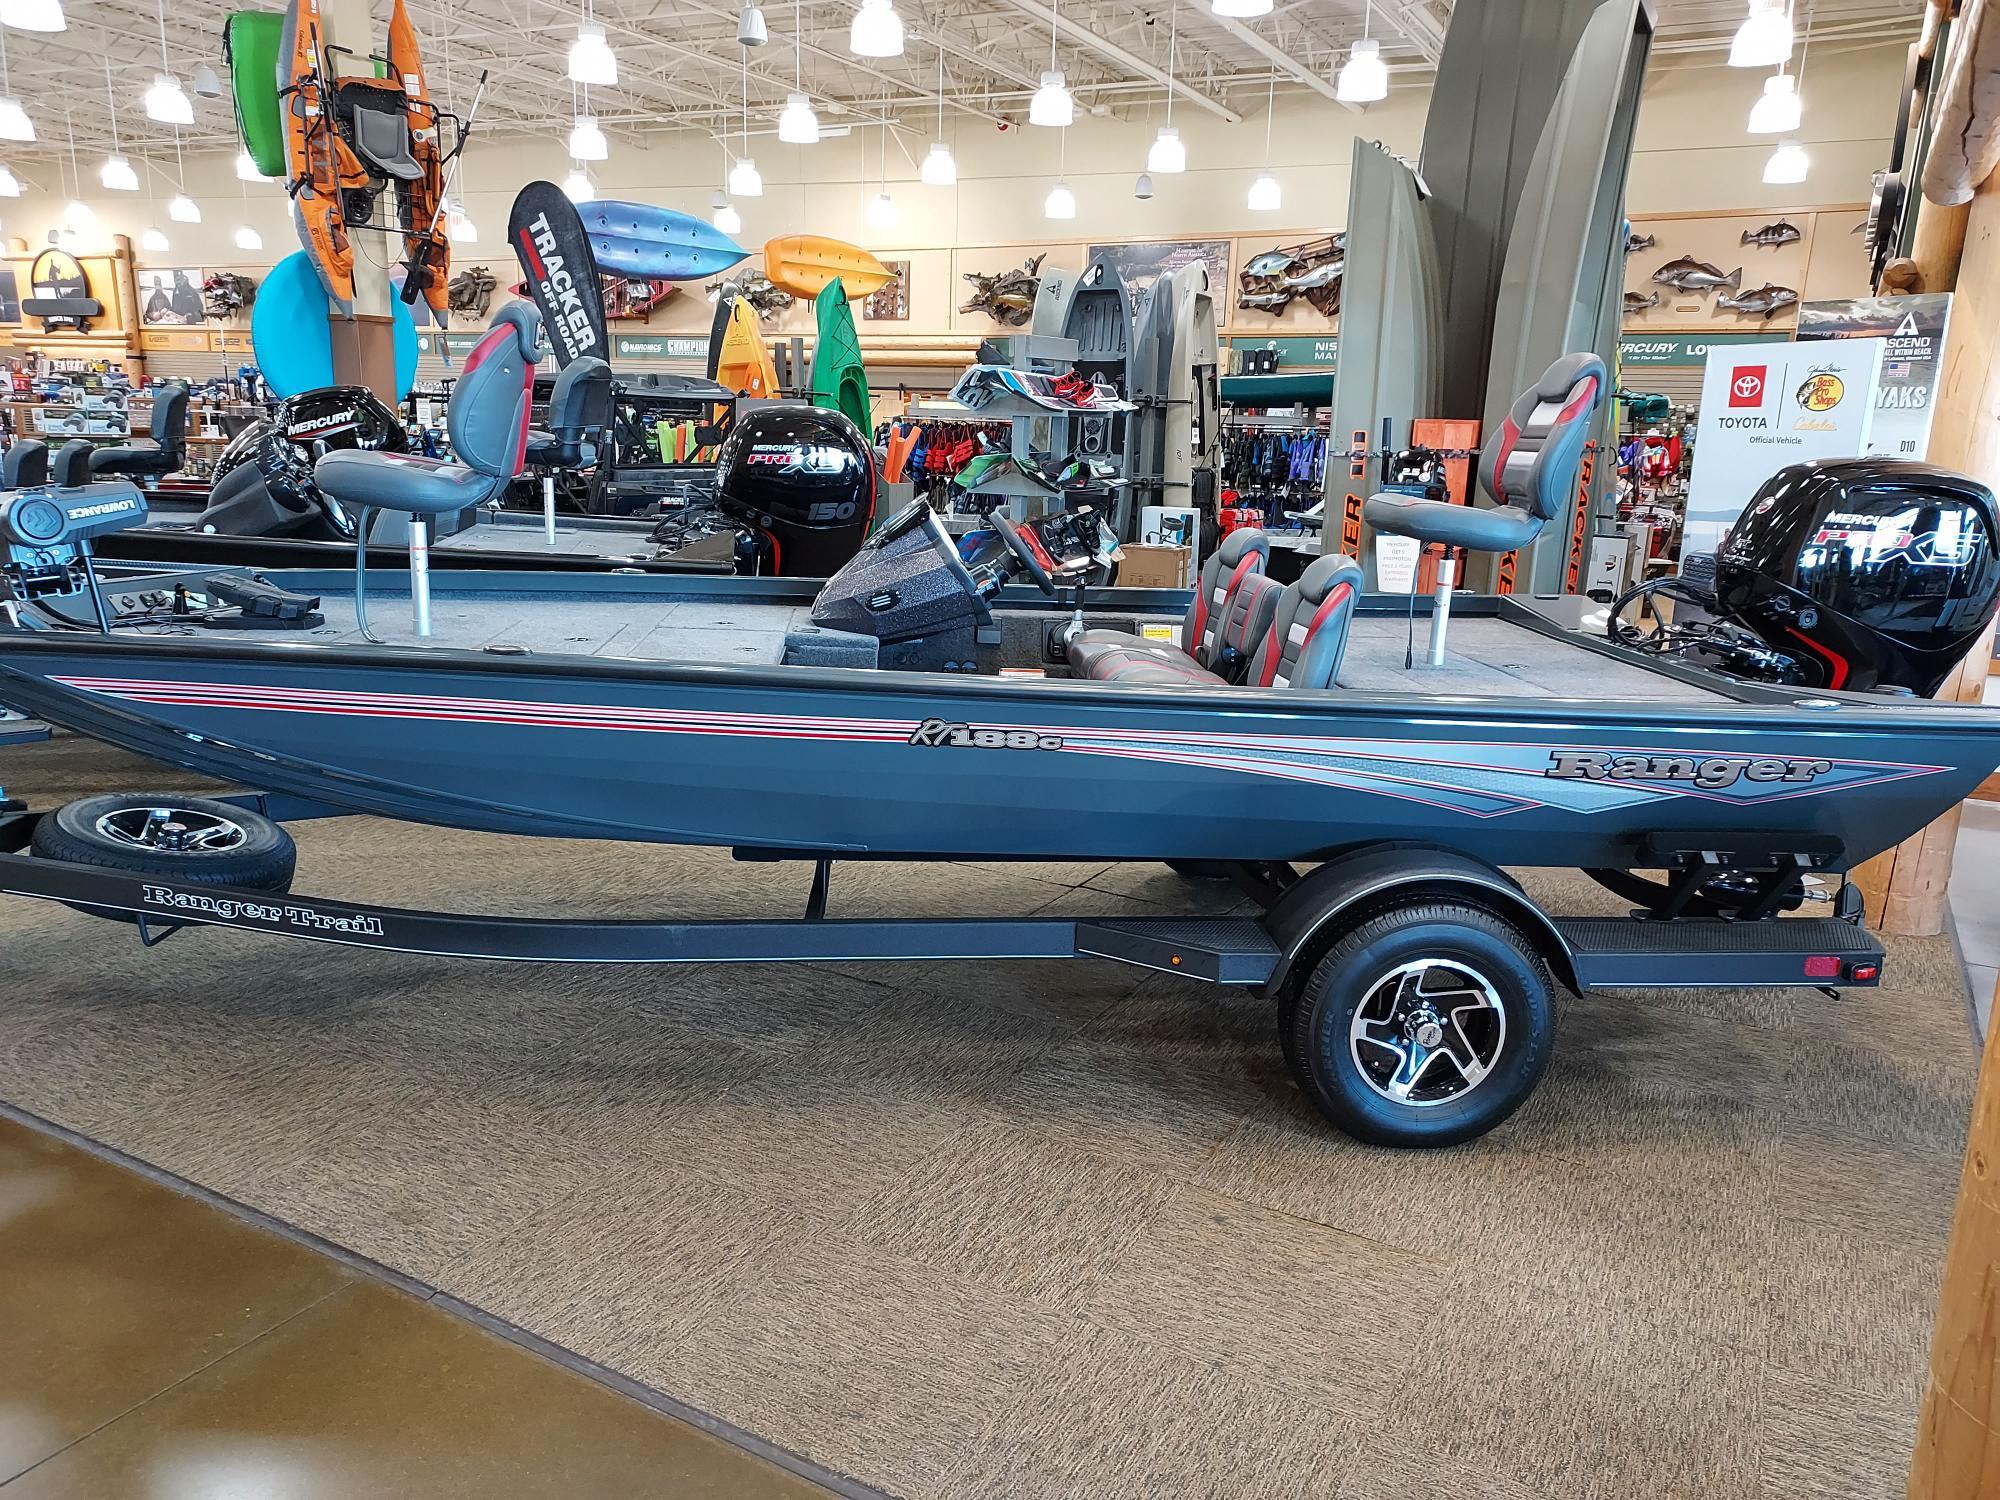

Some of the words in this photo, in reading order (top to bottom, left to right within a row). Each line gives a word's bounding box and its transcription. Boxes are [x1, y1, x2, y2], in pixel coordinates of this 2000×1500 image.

[529, 212, 596, 352] TRACKER
[540, 280, 559, 313] OFF
[554, 313, 579, 360] ROAD
[667, 340, 709, 352] CHAMPION
[1686, 345, 1709, 355] LO
[1894, 348, 1914, 356] WITHIN
[1816, 377, 1835, 387] Bass
[1814, 387, 1829, 396] Pro
[1814, 396, 1836, 407] Shops
[287, 409, 355, 437] MERCURY
[1718, 417, 1767, 428] TOYOTA
[1749, 436, 1775, 444] Official
[1776, 436, 1802, 444] Vehicle
[1900, 440, 1915, 452] D10
[752, 444, 798, 452] MERCURY
[67, 498, 137, 521] LOWRANCE
[807, 501, 856, 520] 150
[1824, 512, 1903, 527] MERCUR
[1545, 751, 1832, 788] Ranger
[142, 884, 283, 922] Ranger
[286, 906, 384, 936] Trail
